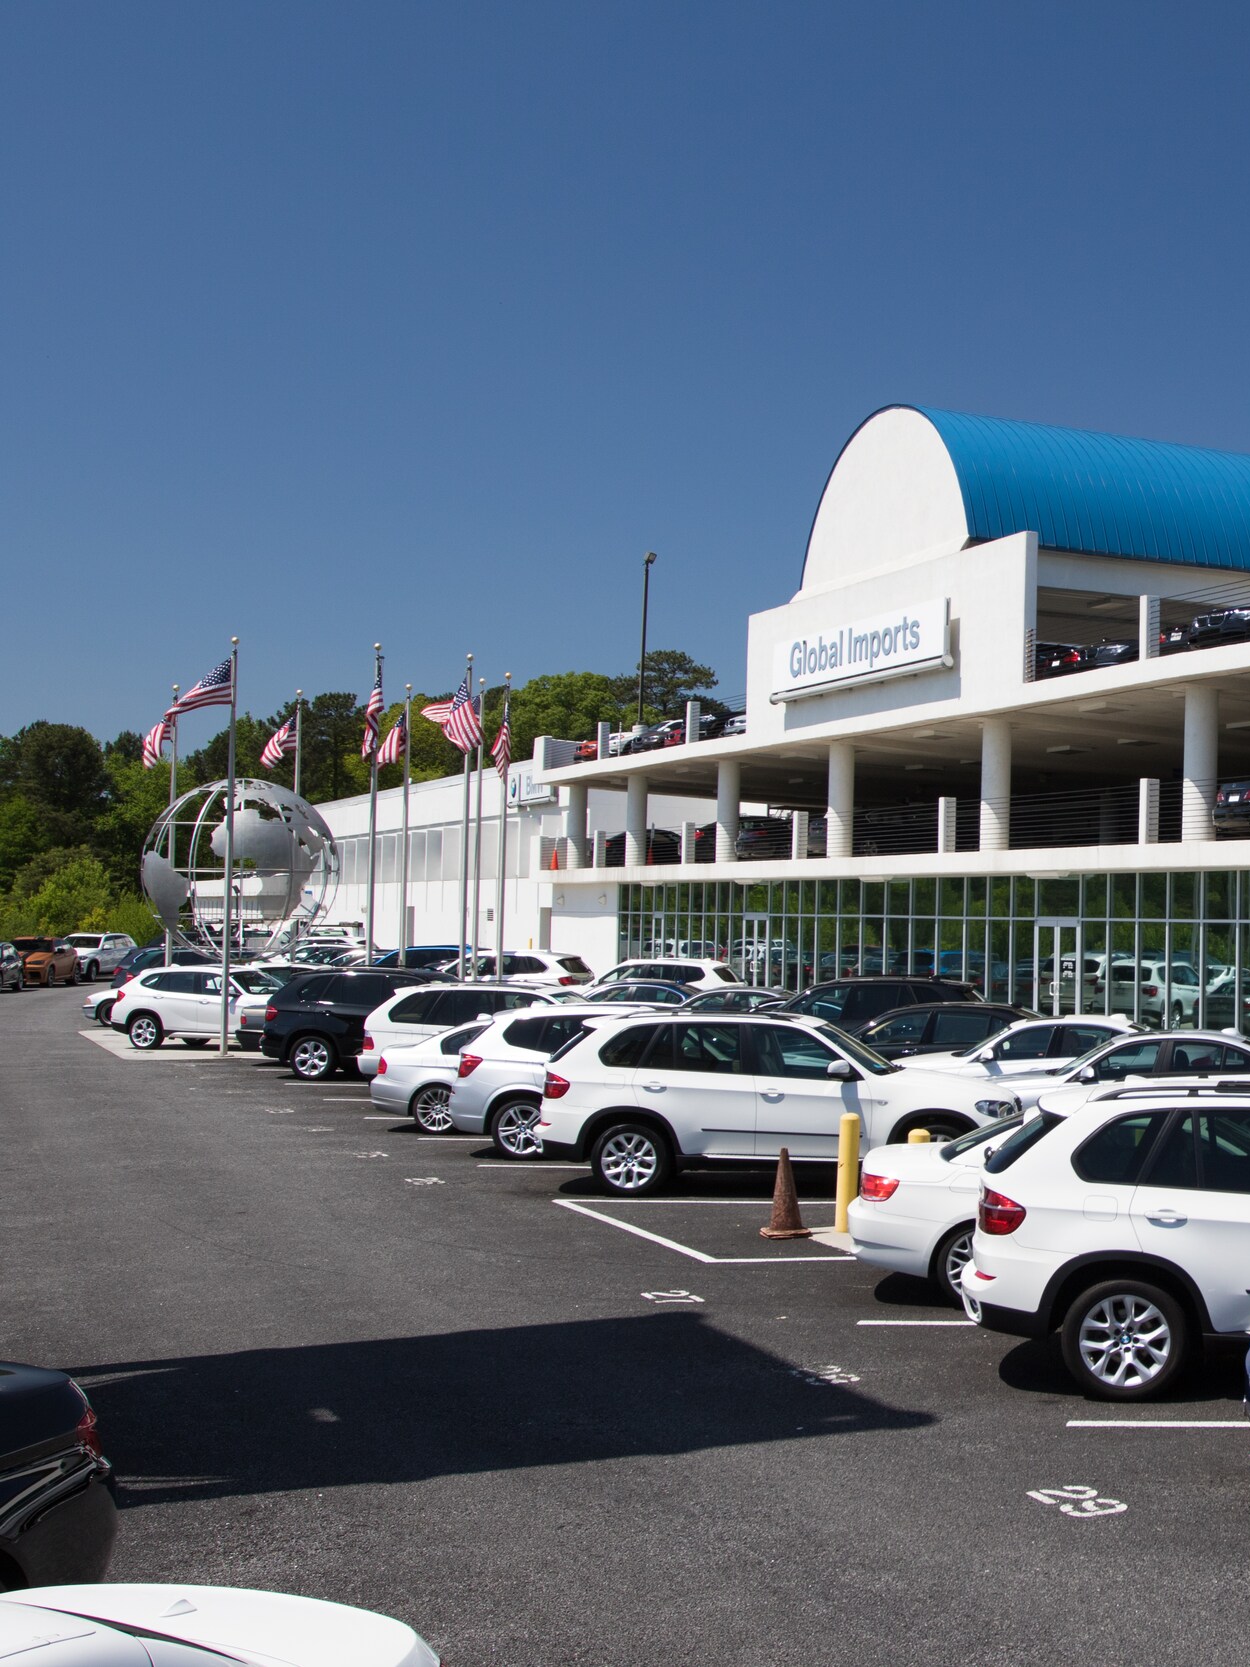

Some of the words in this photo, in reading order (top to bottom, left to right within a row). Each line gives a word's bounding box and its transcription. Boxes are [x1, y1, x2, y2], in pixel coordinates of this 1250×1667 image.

[789, 630, 844, 679] Global
[848, 616, 921, 668] Imports
[1025, 1485, 1129, 1518] 29
